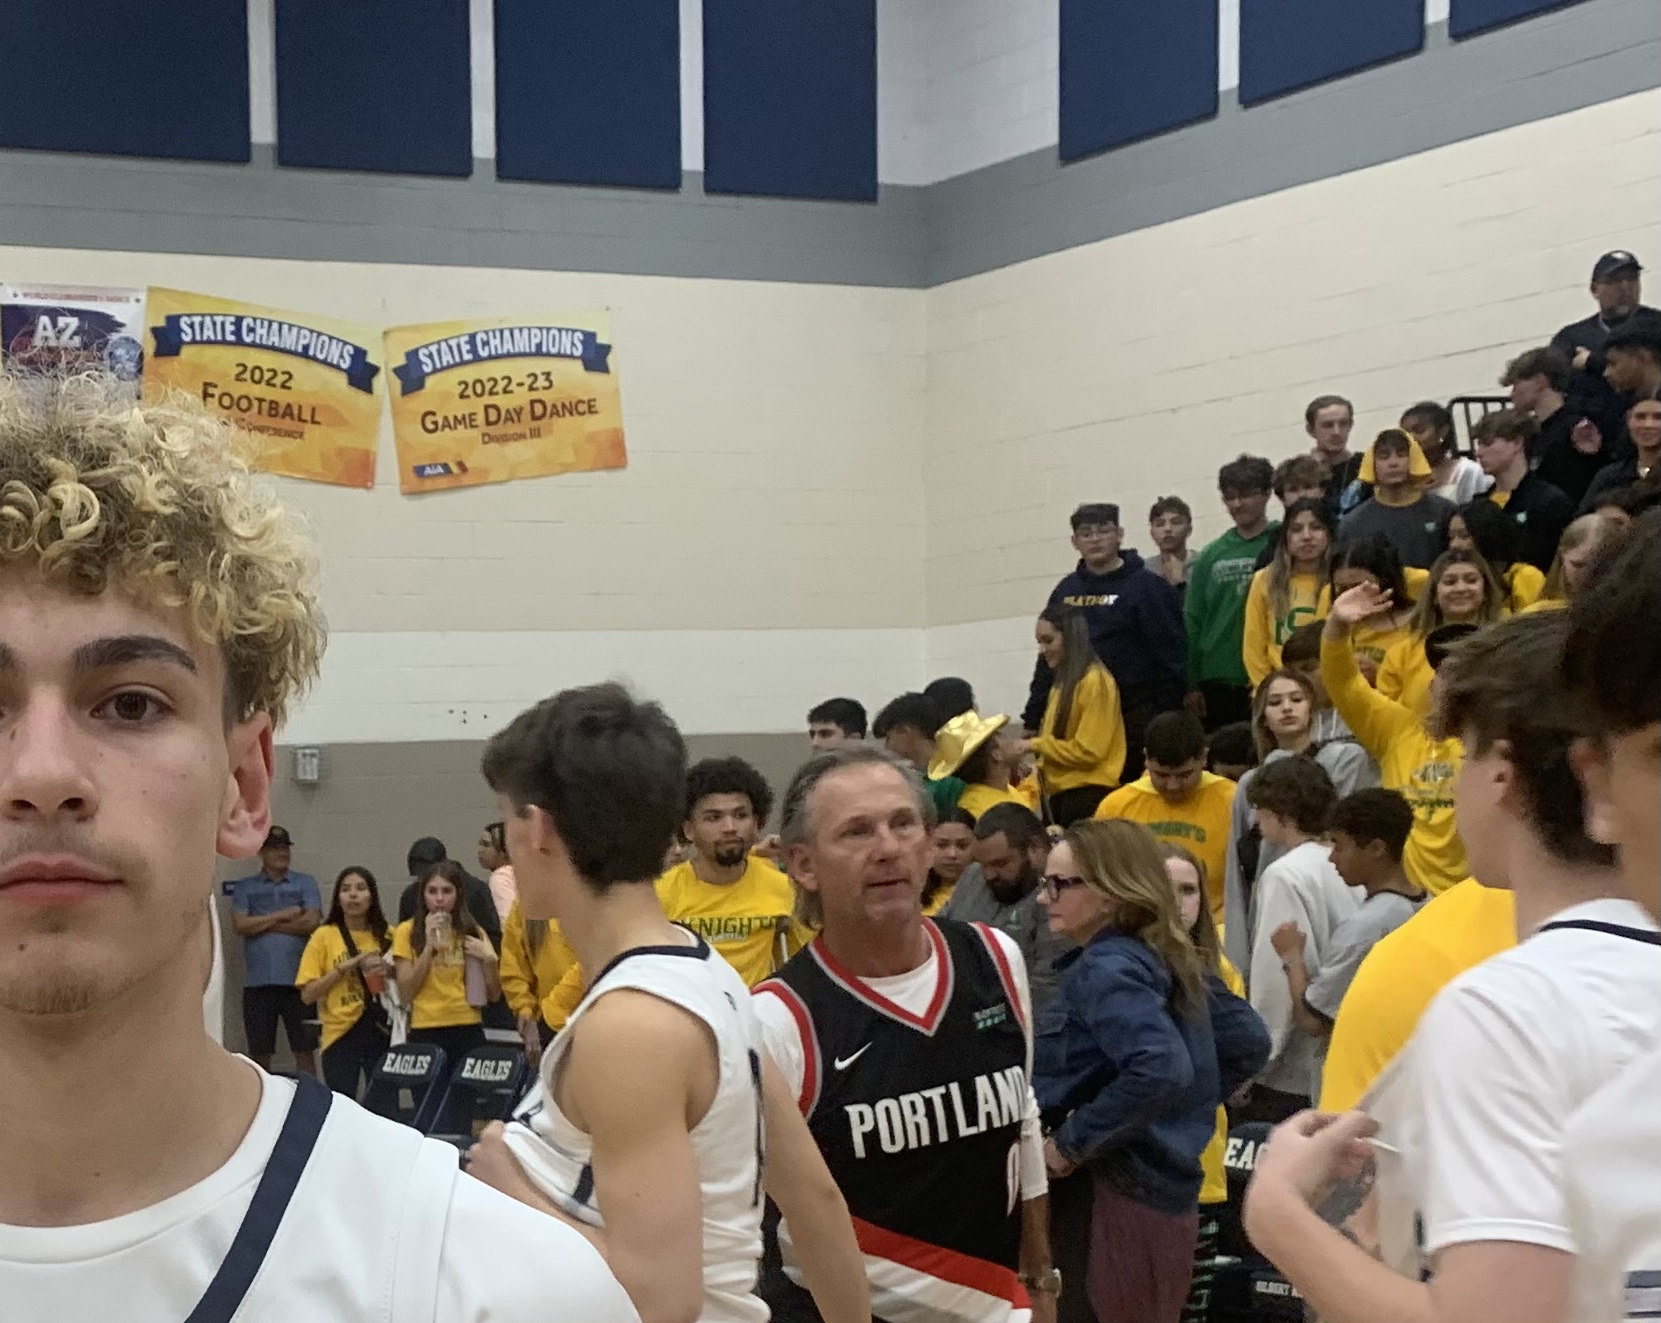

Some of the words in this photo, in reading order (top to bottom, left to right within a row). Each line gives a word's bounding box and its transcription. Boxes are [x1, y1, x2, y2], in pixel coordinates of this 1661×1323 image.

[32, 315, 82, 347] AZ
[179, 316, 236, 342] STATE
[241, 317, 355, 369] CHAMPIONS
[418, 337, 473, 373] STATE
[475, 328, 584, 357] CHAMPIONS
[234, 363, 294, 390] 2022
[458, 371, 554, 399] 2022-23
[202, 382, 322, 425] FOOTBALL
[382, 1053, 431, 1075] EAGLES
[461, 1057, 512, 1081] EAGLES
